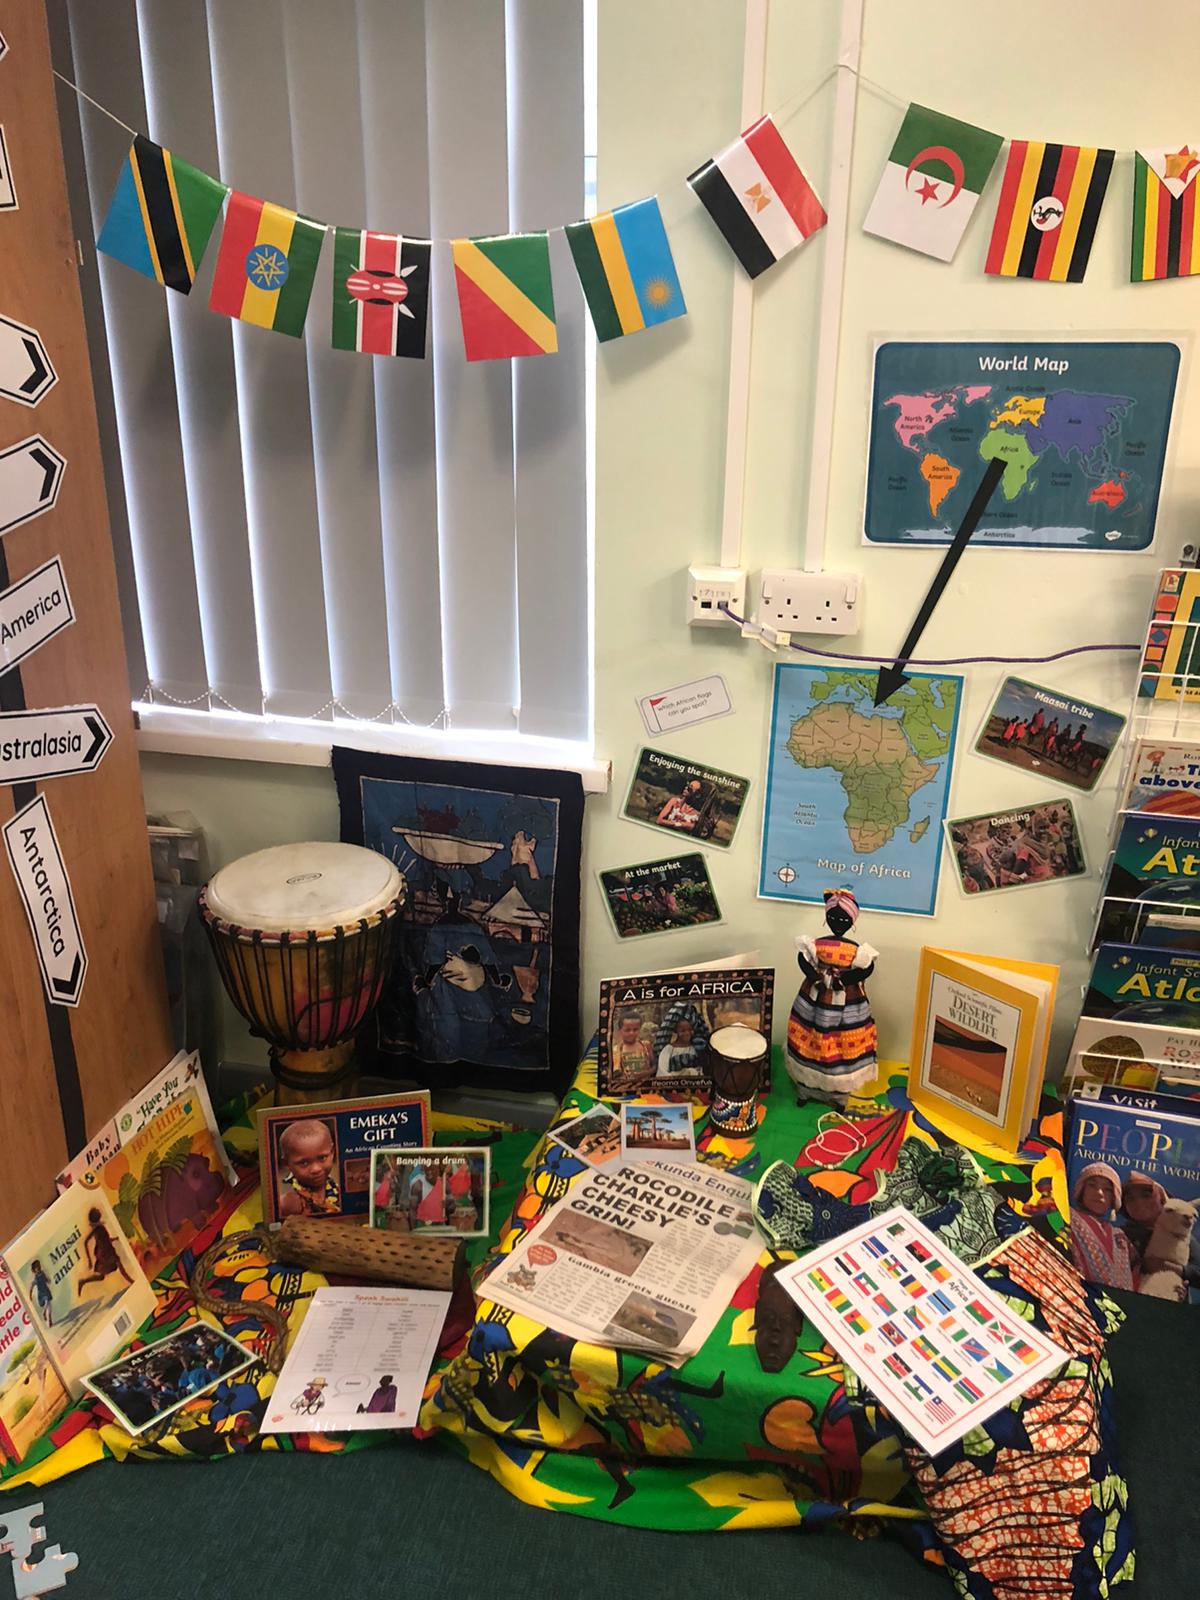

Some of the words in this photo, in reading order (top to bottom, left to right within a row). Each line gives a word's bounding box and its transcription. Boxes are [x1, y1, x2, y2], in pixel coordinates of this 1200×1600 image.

[979, 356, 1028, 372] World
[1034, 356, 1070, 375] Map
[900, 422, 926, 431] America
[904, 415, 923, 423] North
[1000, 445, 1019, 453] Africa
[983, 531, 1016, 539] Antarctica
[1, 589, 62, 645] America
[1034, 690, 1070, 711] Maasai
[1070, 701, 1094, 719] tribe
[648, 752, 686, 773] Enjoying
[686, 762, 701, 776] the
[702, 769, 742, 790] sunshine
[990, 812, 1031, 827] Dancing
[624, 870, 636, 880] At
[636, 867, 650, 878] the
[650, 860, 682, 876] market
[816, 858, 846, 873] Map
[850, 861, 866, 876] of
[868, 863, 912, 879] Africa
[1141, 848, 1200, 876] At
[19, 827, 66, 958] Antarctica
[1136, 962, 1178, 977] Infant
[623, 990, 637, 1001] A
[641, 988, 655, 999] is
[660, 985, 684, 998] for
[688, 981, 754, 996] AFRICA
[948, 1006, 999, 1040] WILDLIFE
[953, 995, 997, 1025] DESERT
[161, 1076, 179, 1098] You
[1110, 1093, 1158, 1110] Visit
[349, 1111, 409, 1130] EMEKA'S
[131, 1127, 155, 1155] HOT
[363, 1127, 397, 1142] GIFT
[86, 1135, 111, 1166] Baby
[396, 1156, 433, 1167] Banging
[441, 1155, 467, 1166] drum
[1074, 1147, 1131, 1167] AROUND
[1134, 1160, 1157, 1173] THE
[592, 1173, 713, 1226] CHARLIE'S
[617, 1166, 735, 1218] ROCODILE
[570, 1199, 637, 1230] GRIN!
[581, 1186, 675, 1228] CHEESY
[48, 1224, 82, 1265] Masai
[53, 1254, 75, 1285] and
[74, 1249, 82, 1262] I
[568, 1256, 611, 1278] Gambia
[614, 1276, 652, 1295] greets
[655, 1293, 697, 1313] guests
[948, 1281, 969, 1302] Africa
[0, 1295, 21, 1327] ead
